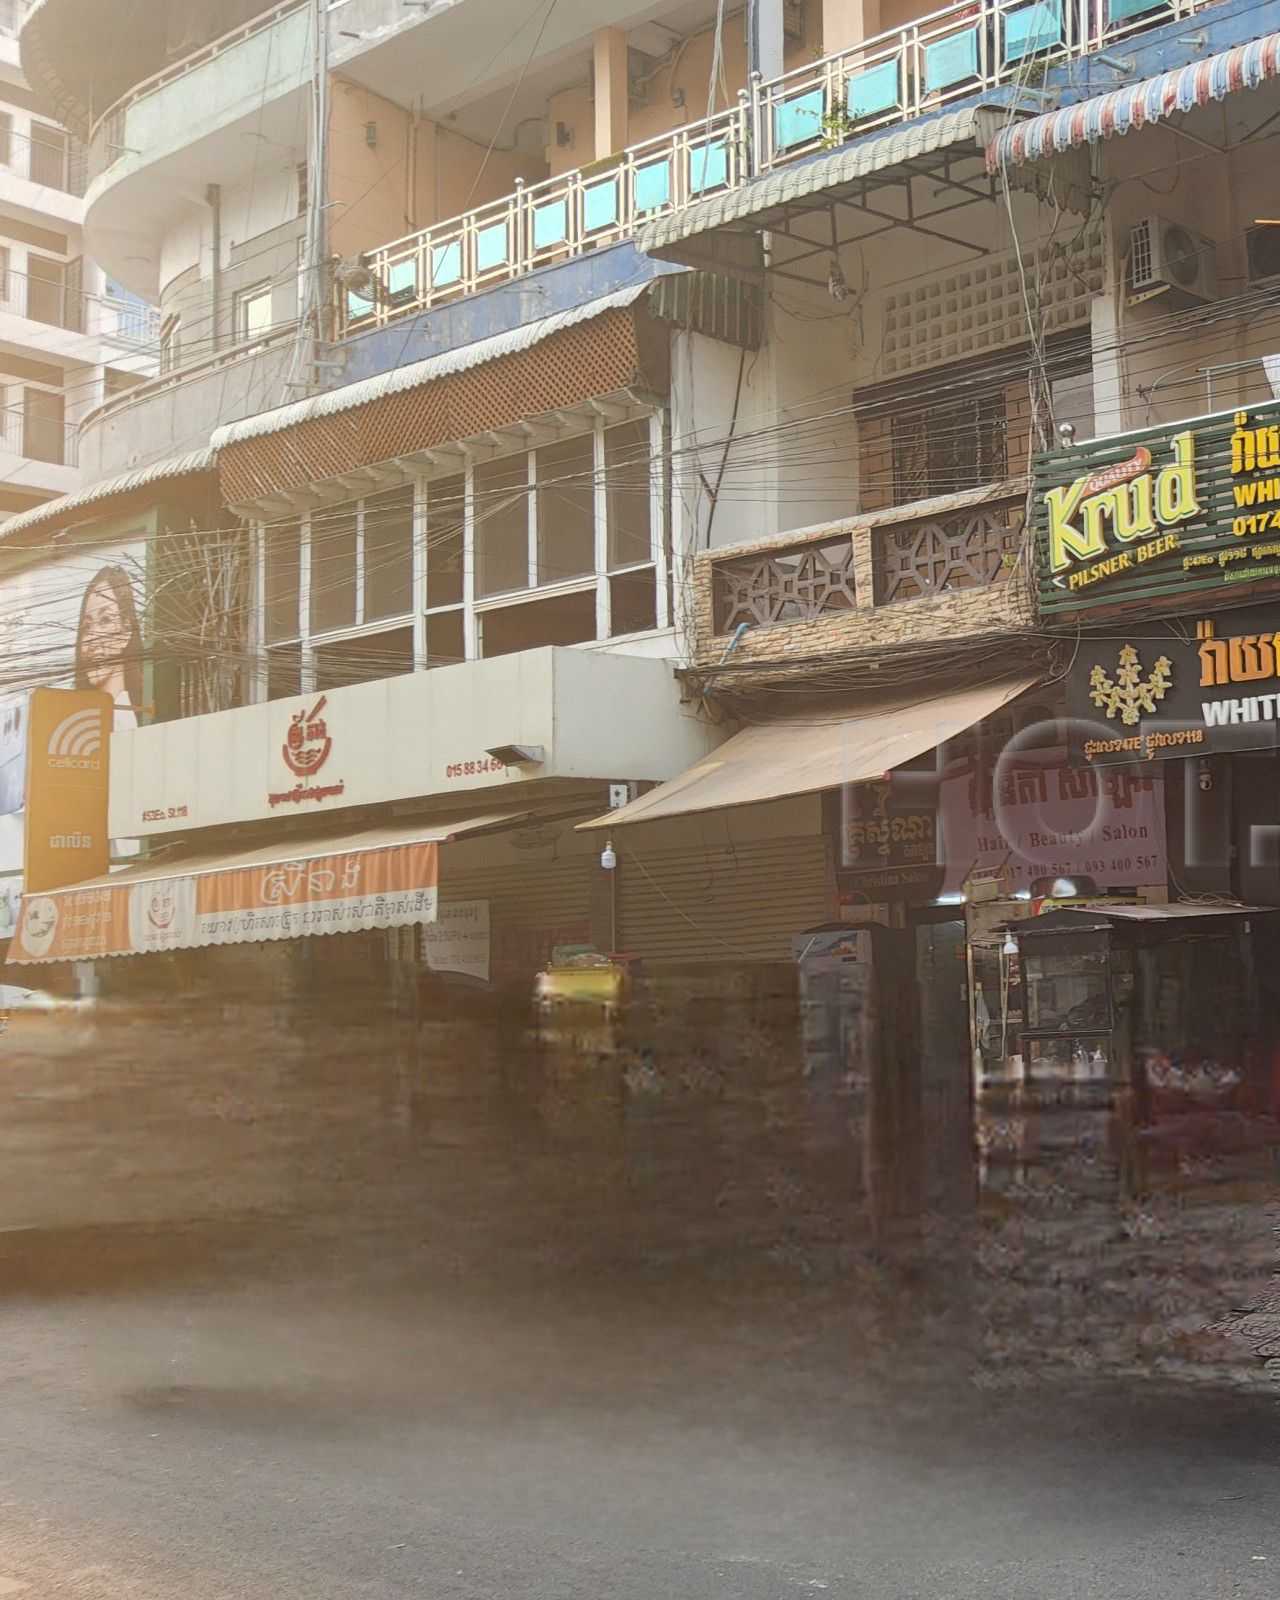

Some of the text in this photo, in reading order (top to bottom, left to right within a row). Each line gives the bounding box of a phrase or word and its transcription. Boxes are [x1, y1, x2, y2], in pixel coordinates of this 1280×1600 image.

[1087, 457, 1146, 494] QUALITY
[1044, 431, 1199, 573] Krud
[1069, 535, 1179, 592] PILSNER BEER
[446, 764, 462, 778] 015
[463, 761, 475, 775] 88
[476, 759, 489, 773] 34
[977, 835, 1009, 852] Hair
[1030, 831, 1083, 849] Beauty
[1103, 824, 1148, 841] Salon
[1027, 863, 1047, 877] 400
[1051, 862, 1071, 876] 567
[1085, 860, 1105, 872] 093
[1110, 858, 1131, 872] 400
[1136, 855, 1157, 869] 567
